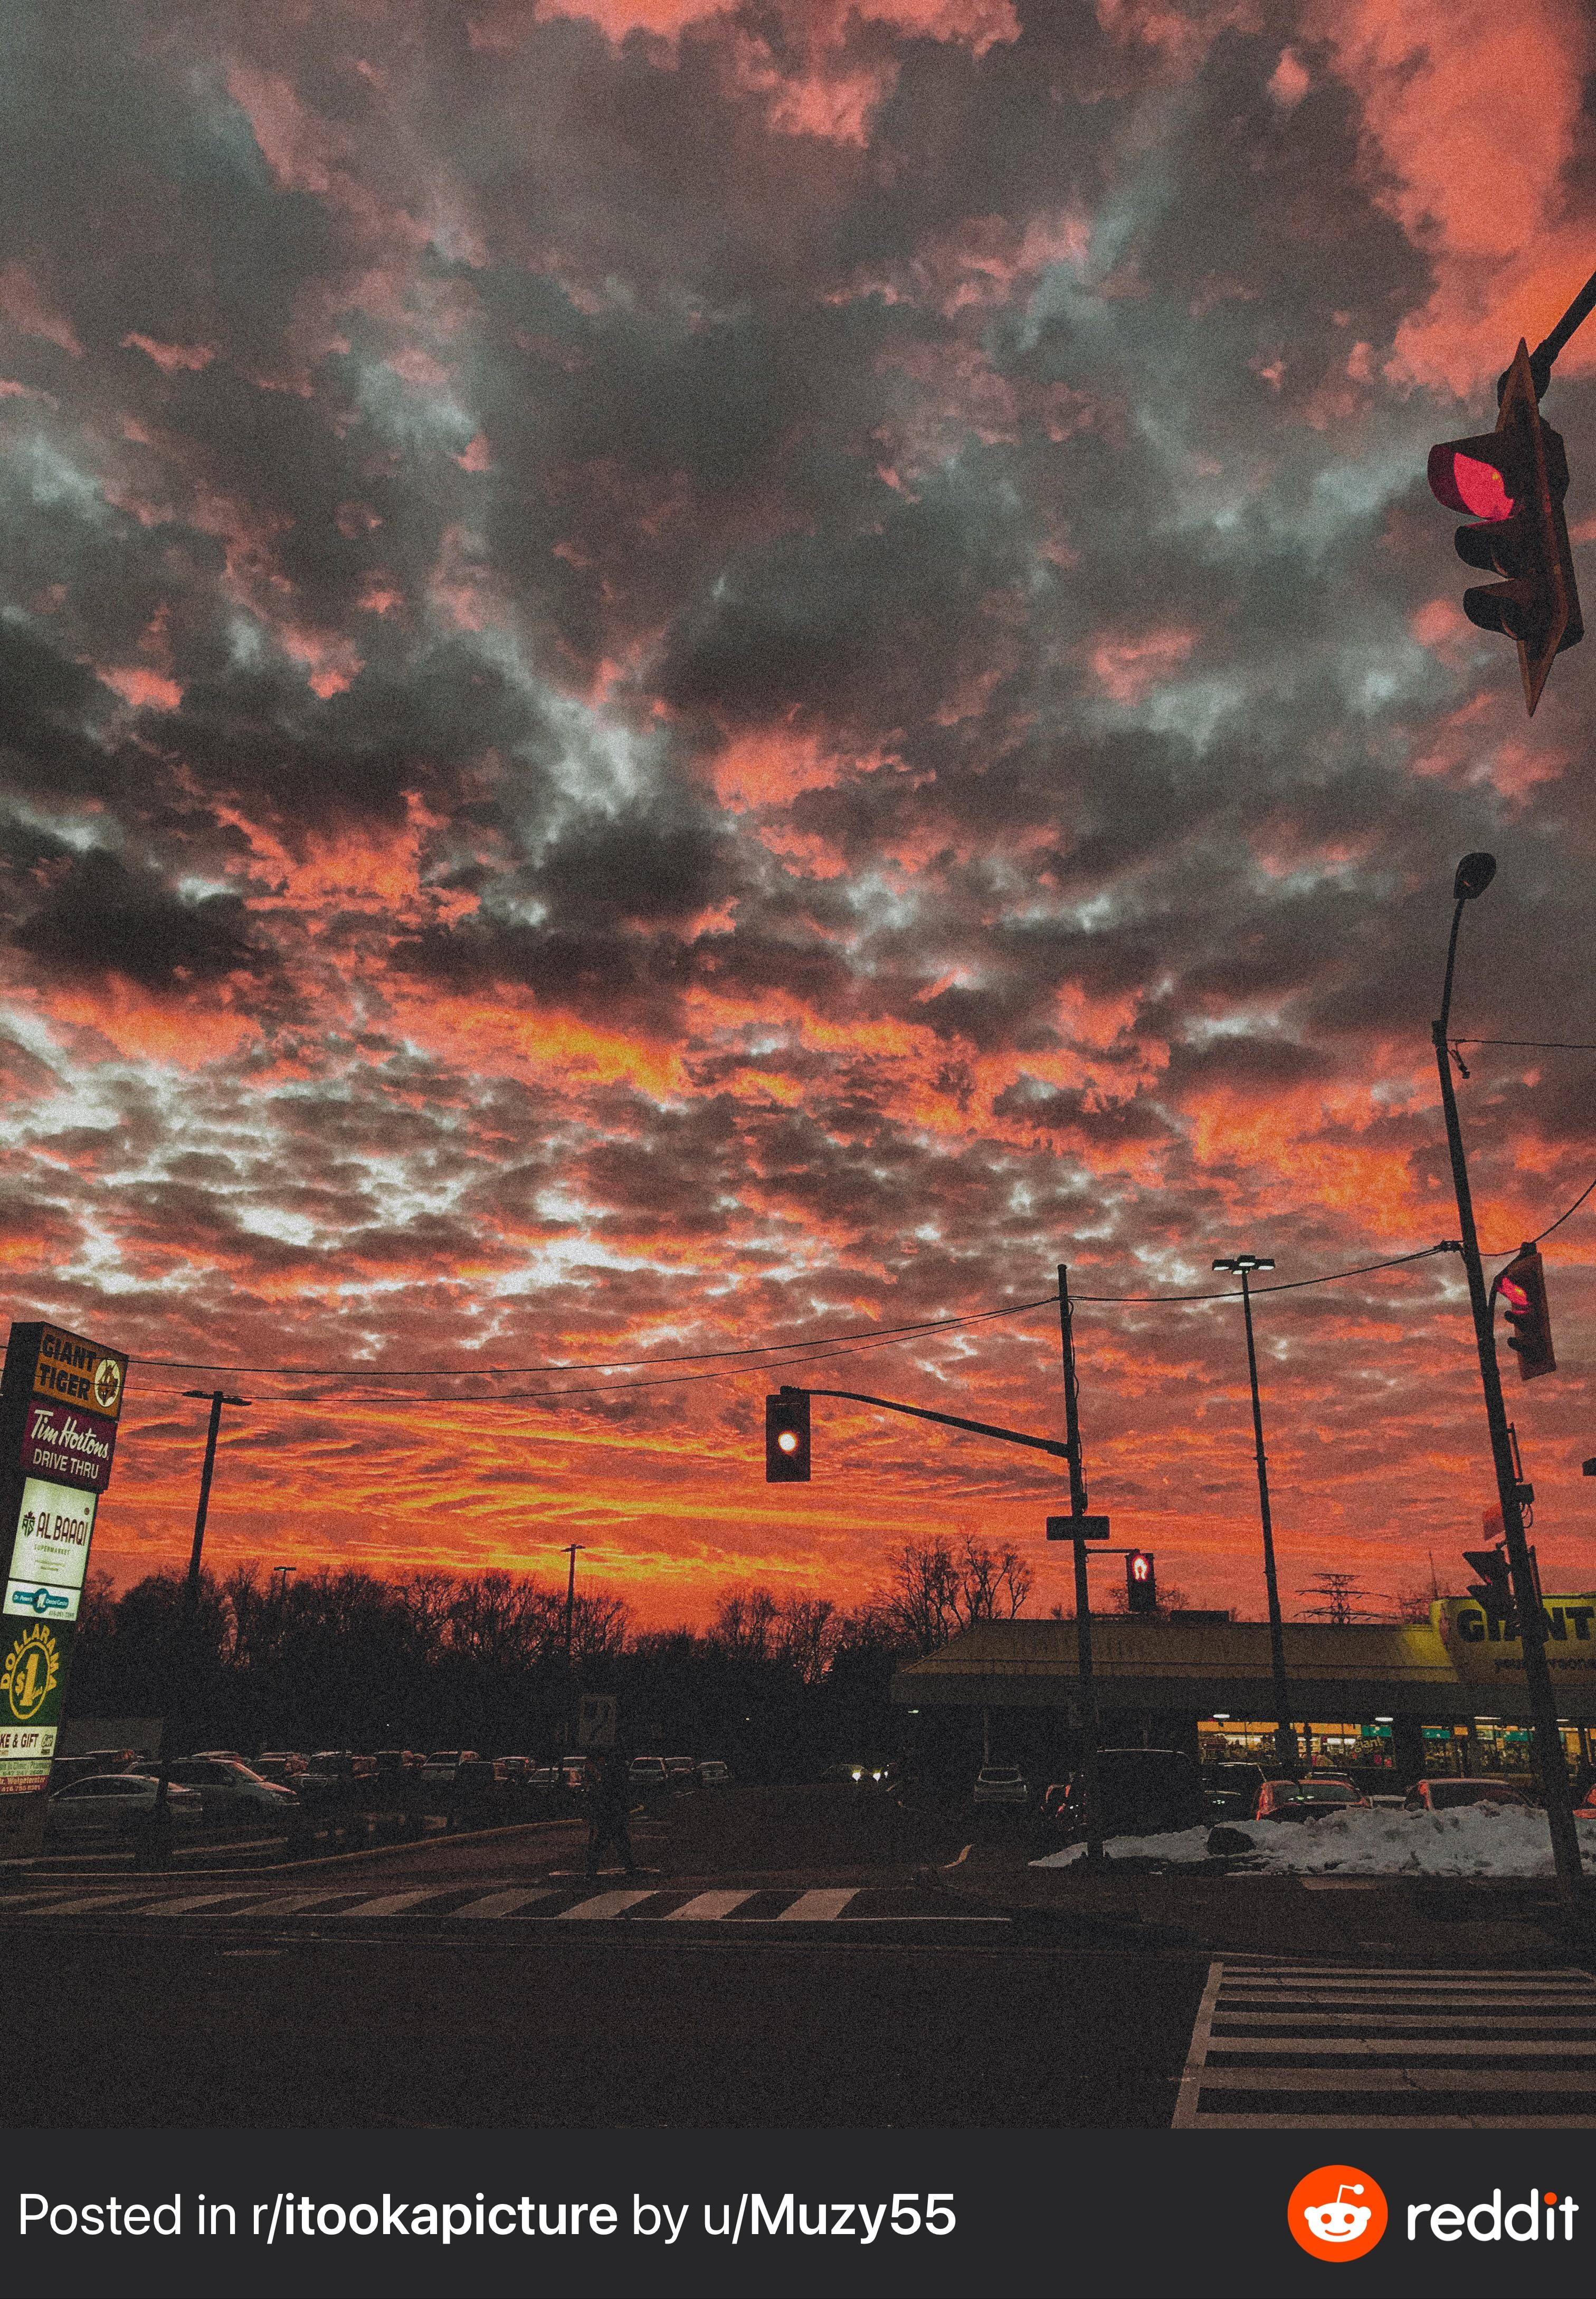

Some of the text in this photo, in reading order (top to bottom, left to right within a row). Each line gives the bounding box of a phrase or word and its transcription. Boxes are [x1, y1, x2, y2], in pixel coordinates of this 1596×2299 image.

[42, 1333, 97, 1371] GIANT
[39, 1363, 90, 1401] TIGER
[31, 1409, 109, 1459] Tim Hortons
[33, 1448, 99, 1479] DRIVE THRU
[36, 1512, 88, 1546] AL BAAQI
[34, 1544, 70, 1555] SUPERMARKET
[0, 1623, 60, 1692] DOLLARAMA
[12, 1733, 18, 1748] &
[21, 1733, 39, 1748] GIFT
